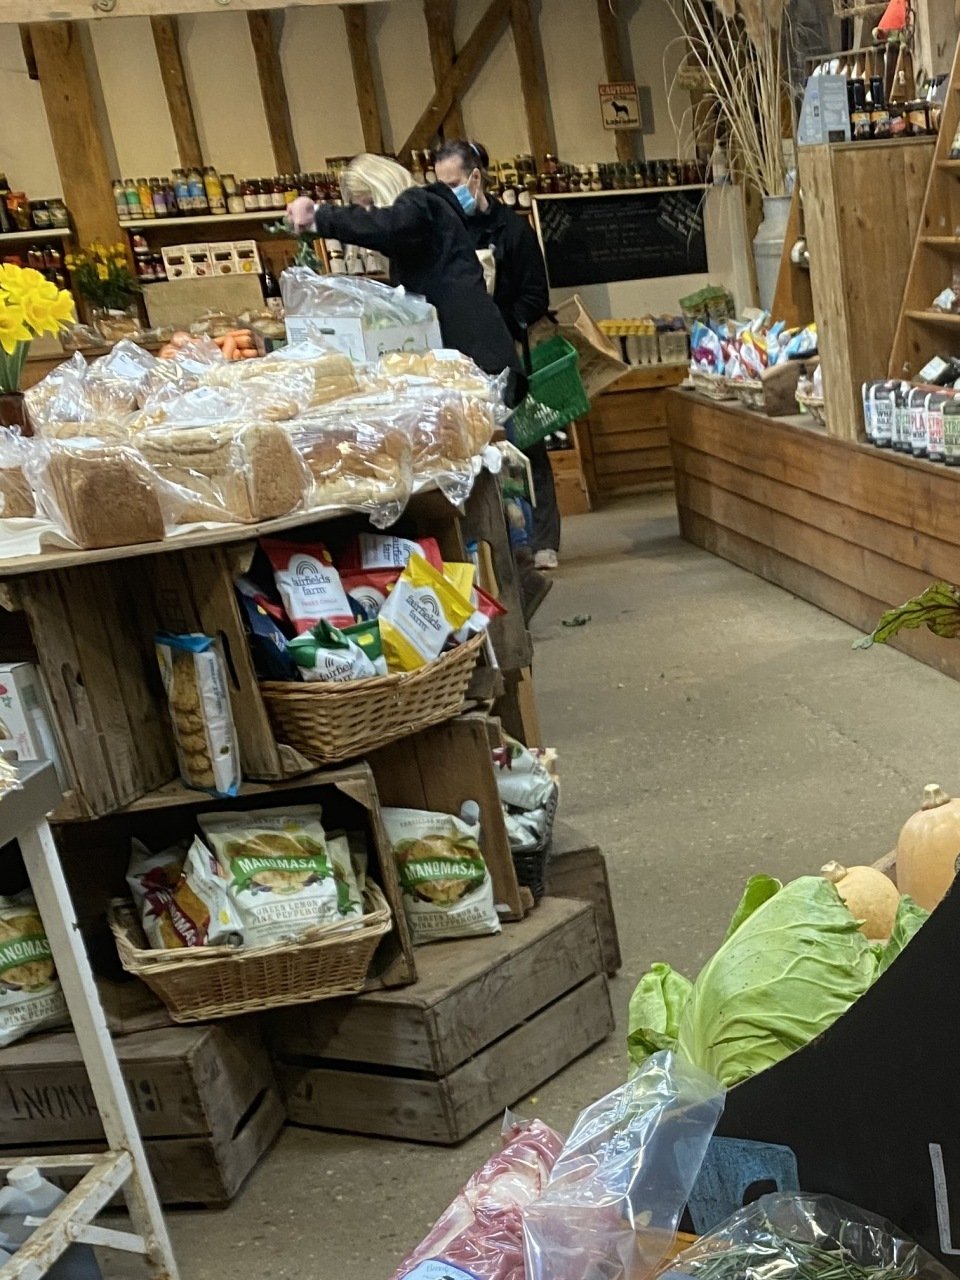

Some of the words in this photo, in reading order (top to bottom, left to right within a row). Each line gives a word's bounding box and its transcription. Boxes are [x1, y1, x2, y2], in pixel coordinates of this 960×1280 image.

[406, 594, 442, 632] fairfields
[238, 857, 317, 874] MANOMASA
[404, 861, 477, 881] MANOMASA
[0, 939, 51, 966] ANOMAS
